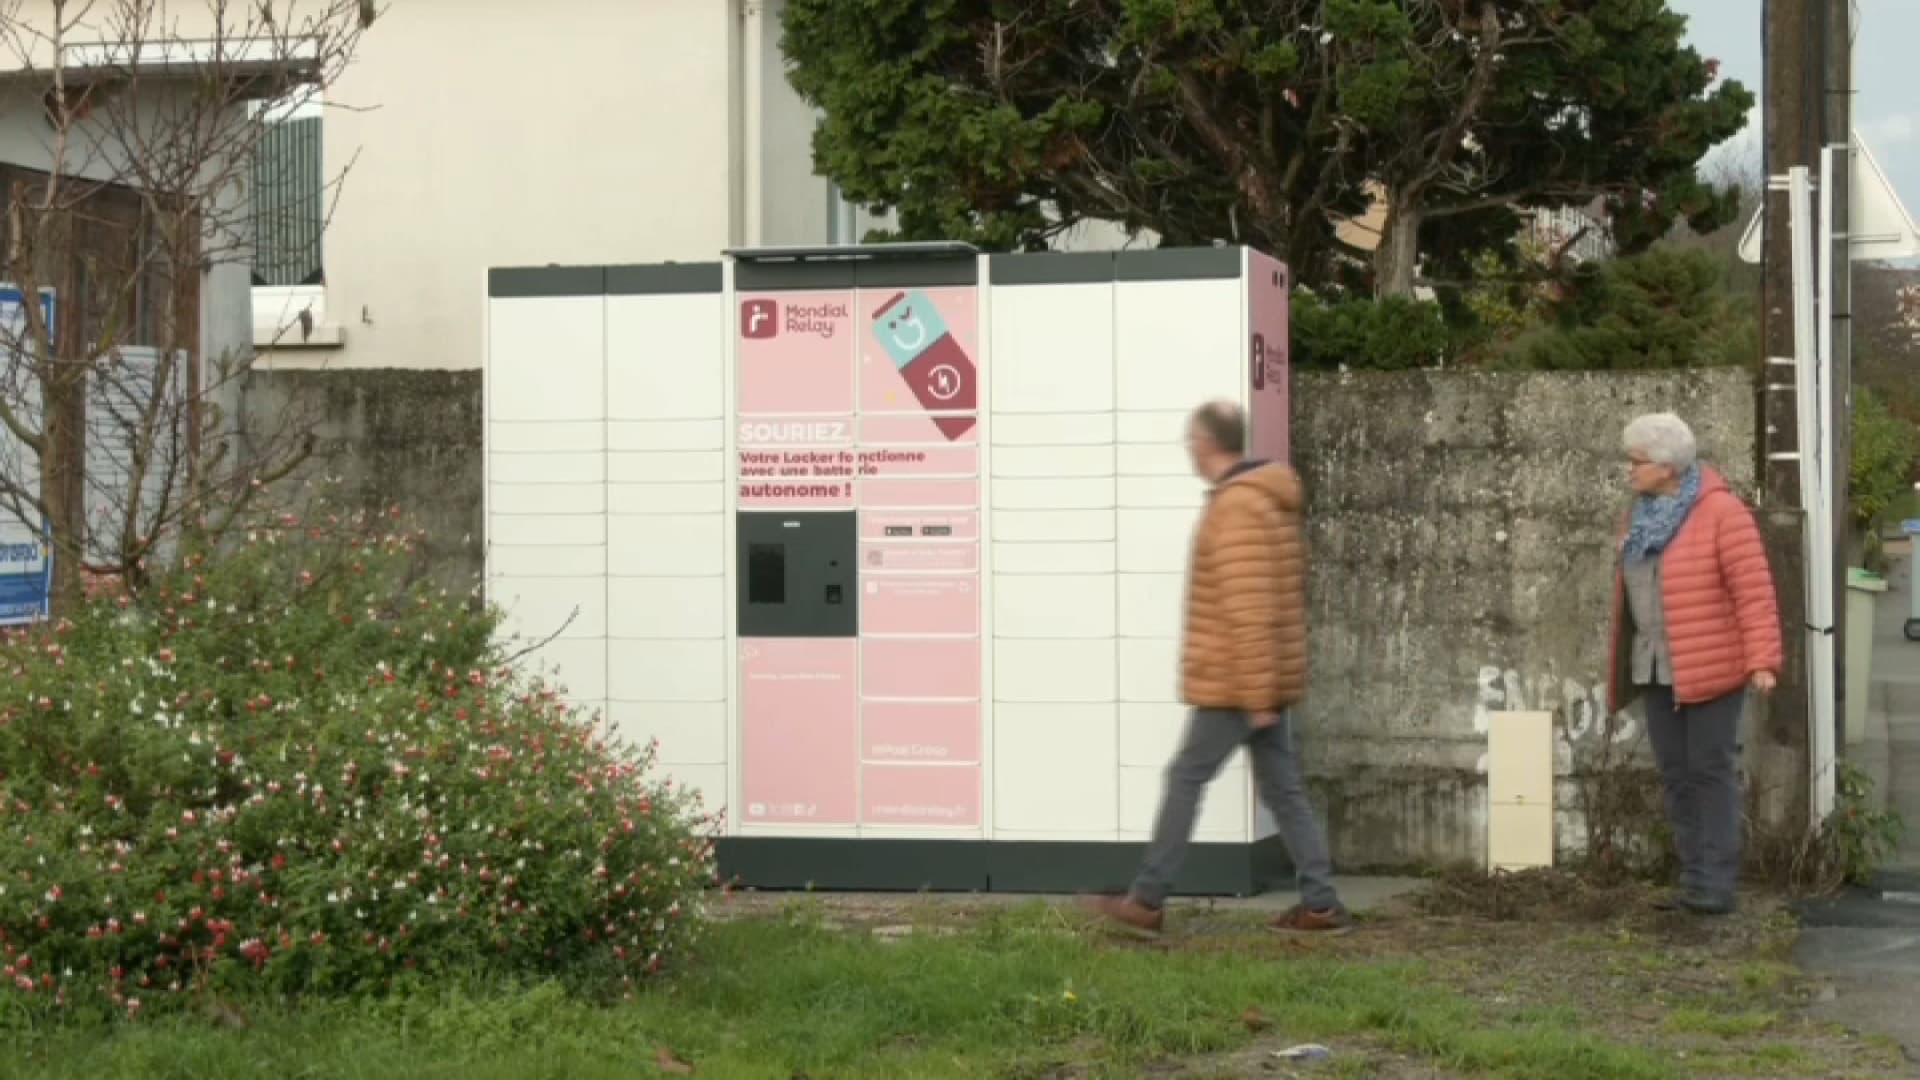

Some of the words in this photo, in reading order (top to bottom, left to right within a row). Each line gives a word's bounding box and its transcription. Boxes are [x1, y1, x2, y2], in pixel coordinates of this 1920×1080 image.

[786, 304, 849, 318] Mondial
[786, 319, 833, 338] Relay
[740, 451, 779, 463] Votre
[784, 451, 833, 463] Locker
[839, 449, 925, 463] fonctionne
[740, 467, 775, 476] avec
[780, 467, 809, 476] une
[813, 464, 878, 476] batterie
[740, 483, 840, 498] autonome
